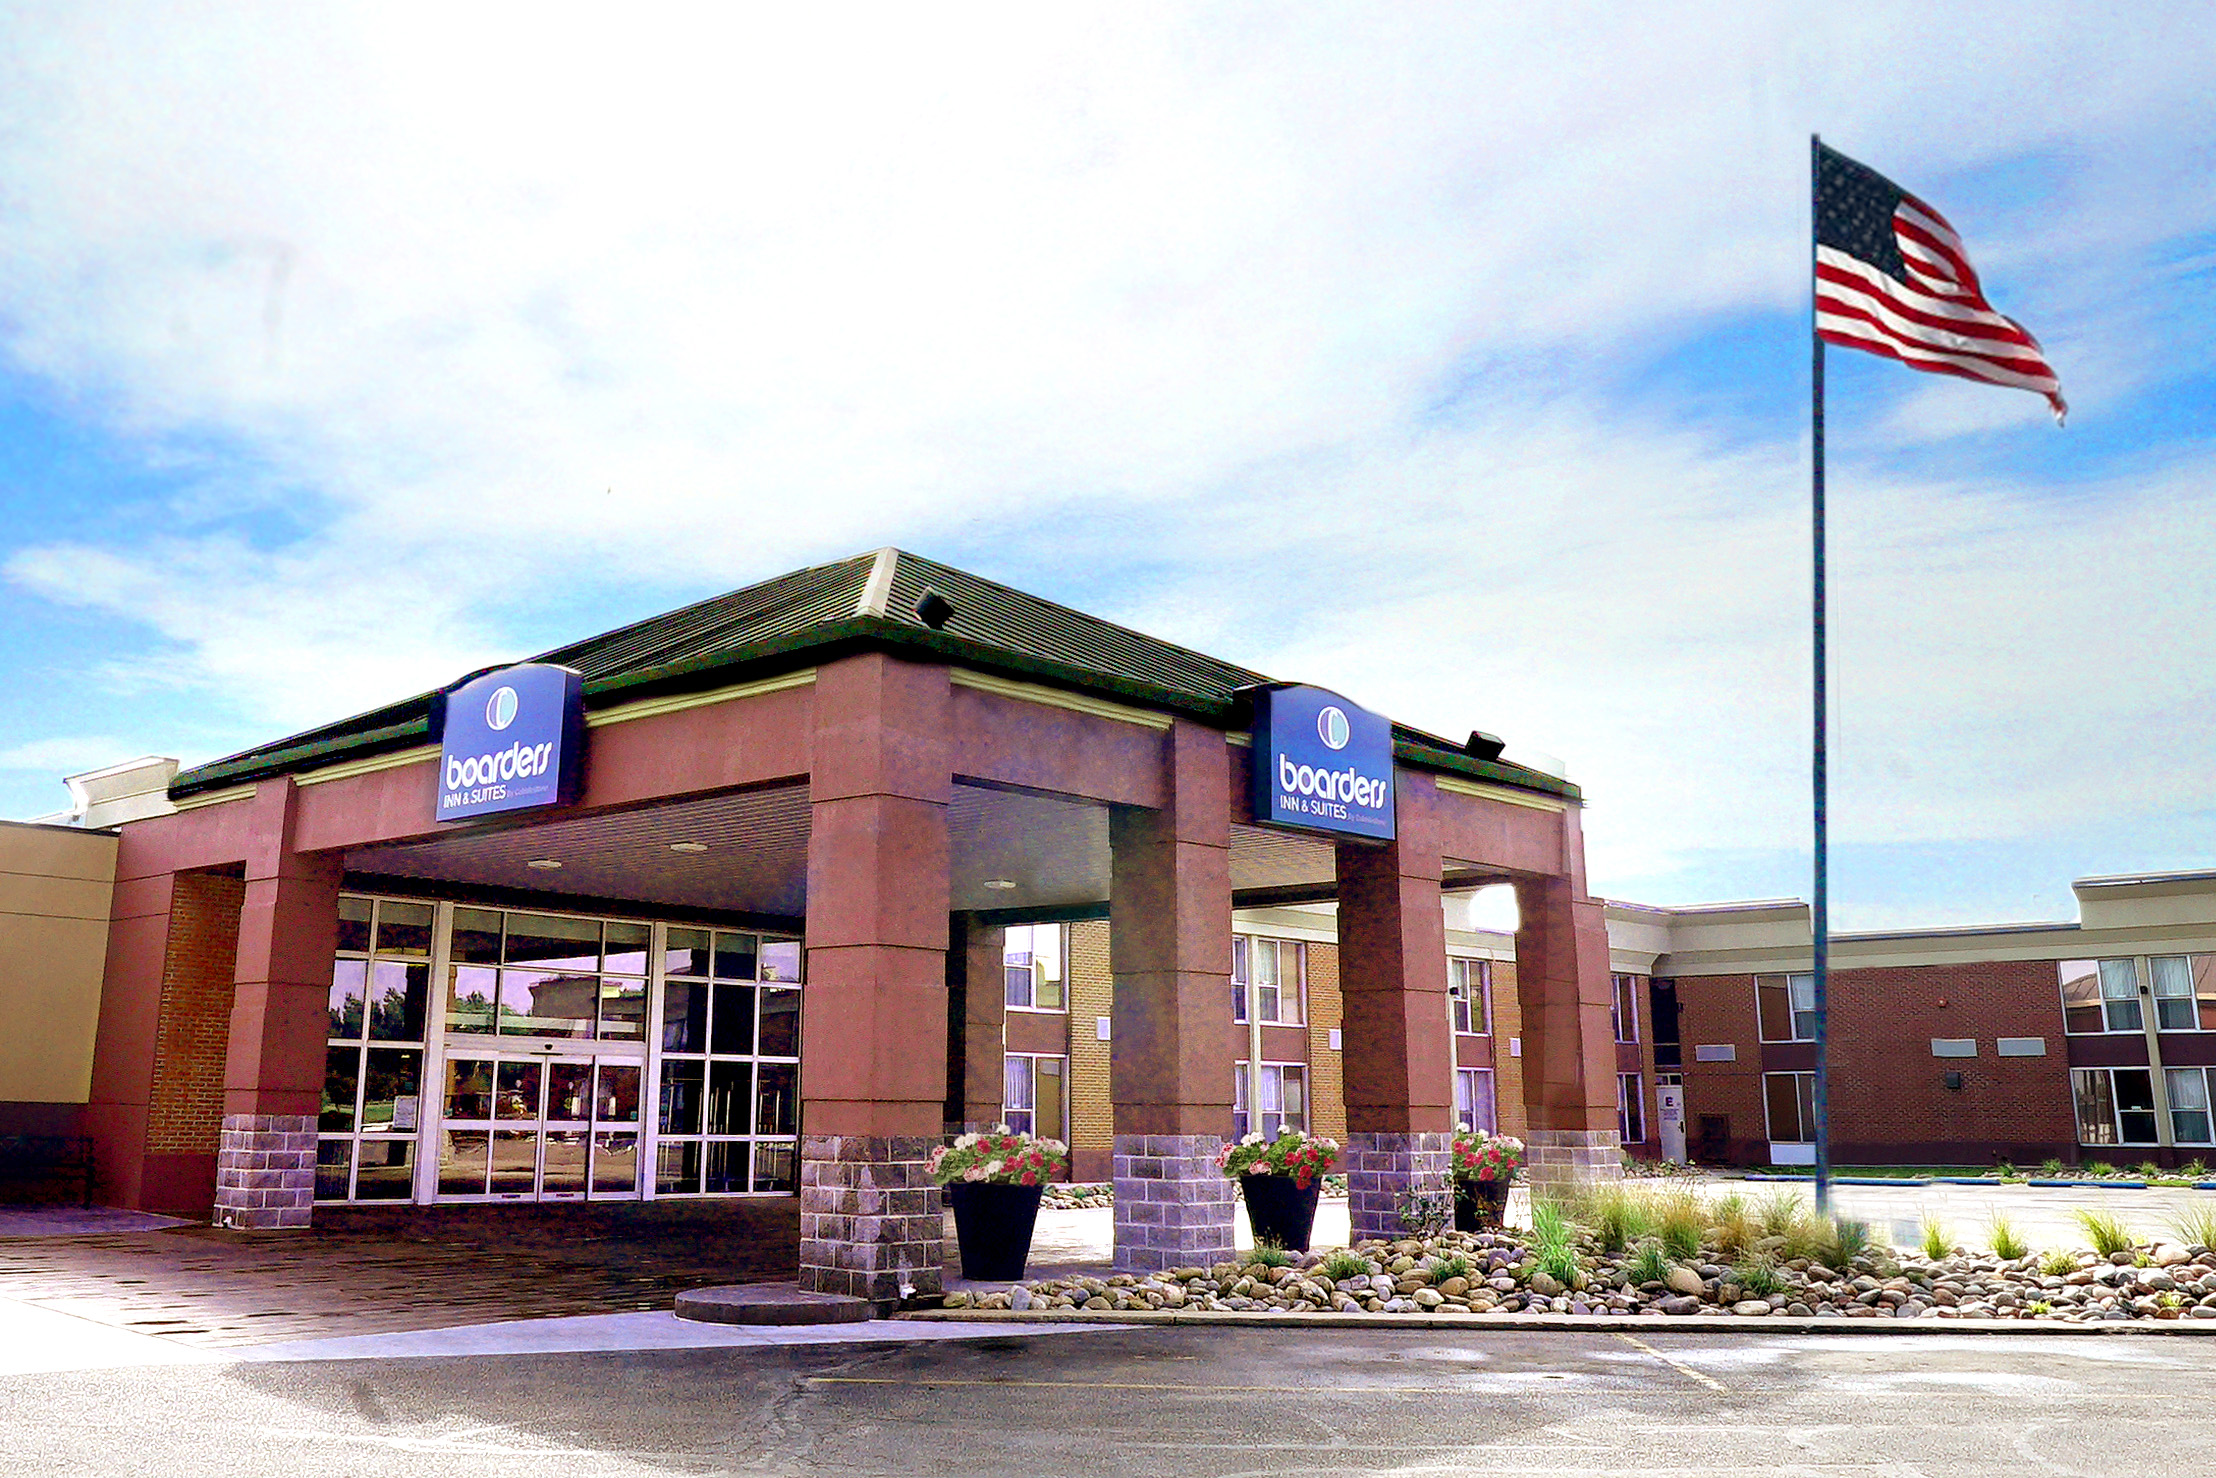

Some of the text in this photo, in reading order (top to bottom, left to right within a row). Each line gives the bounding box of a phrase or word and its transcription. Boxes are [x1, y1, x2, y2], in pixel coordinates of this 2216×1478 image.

[446, 741, 553, 790] boarders
[1279, 753, 1387, 809] boarders
[443, 793, 462, 808] INN
[463, 791, 470, 805] &
[471, 784, 507, 803] SUITES
[1280, 795, 1299, 811] INN
[1301, 799, 1309, 813] &
[1311, 800, 1348, 820] SUITES
[1665, 1097, 1674, 1107] E
